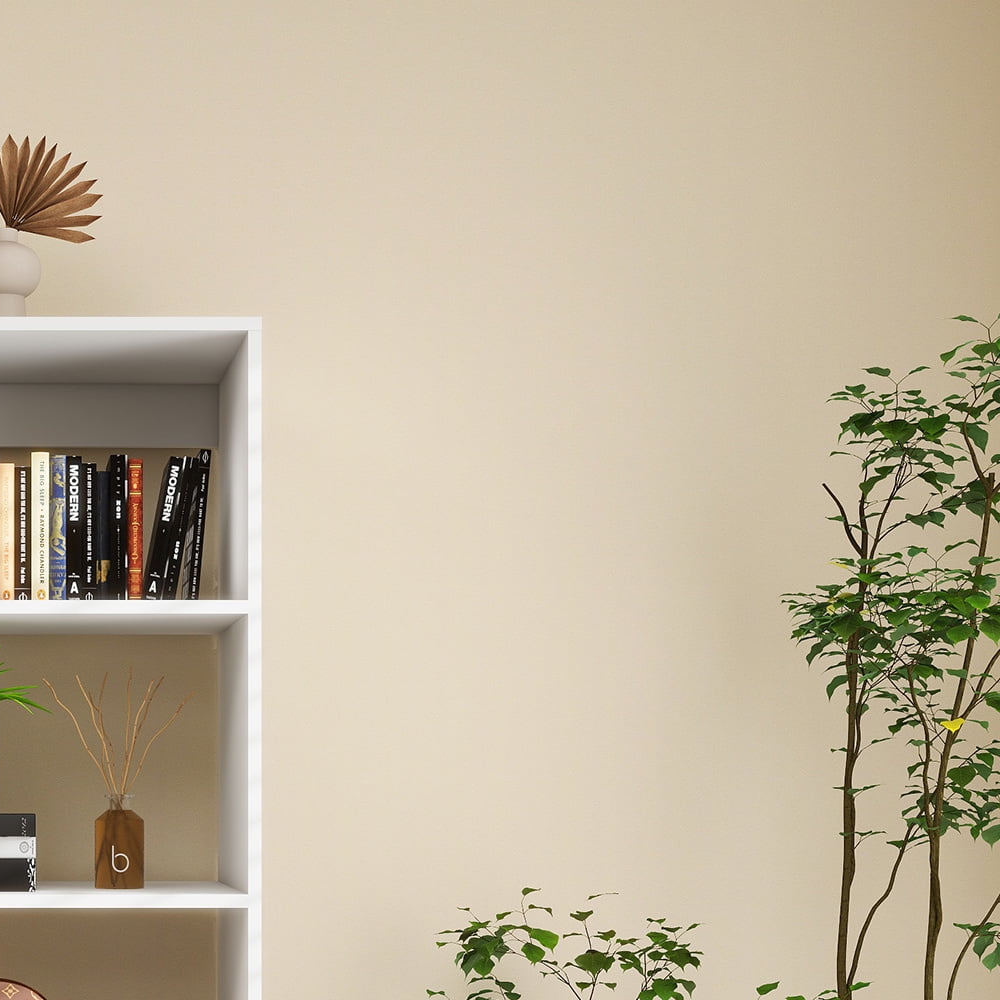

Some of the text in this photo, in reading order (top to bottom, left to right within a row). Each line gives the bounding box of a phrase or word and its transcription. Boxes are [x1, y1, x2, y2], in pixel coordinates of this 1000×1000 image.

[69, 464, 79, 521] MODERN
[161, 465, 180, 522] MODERN
[70, 582, 79, 594] A
[111, 845, 130, 873] b
